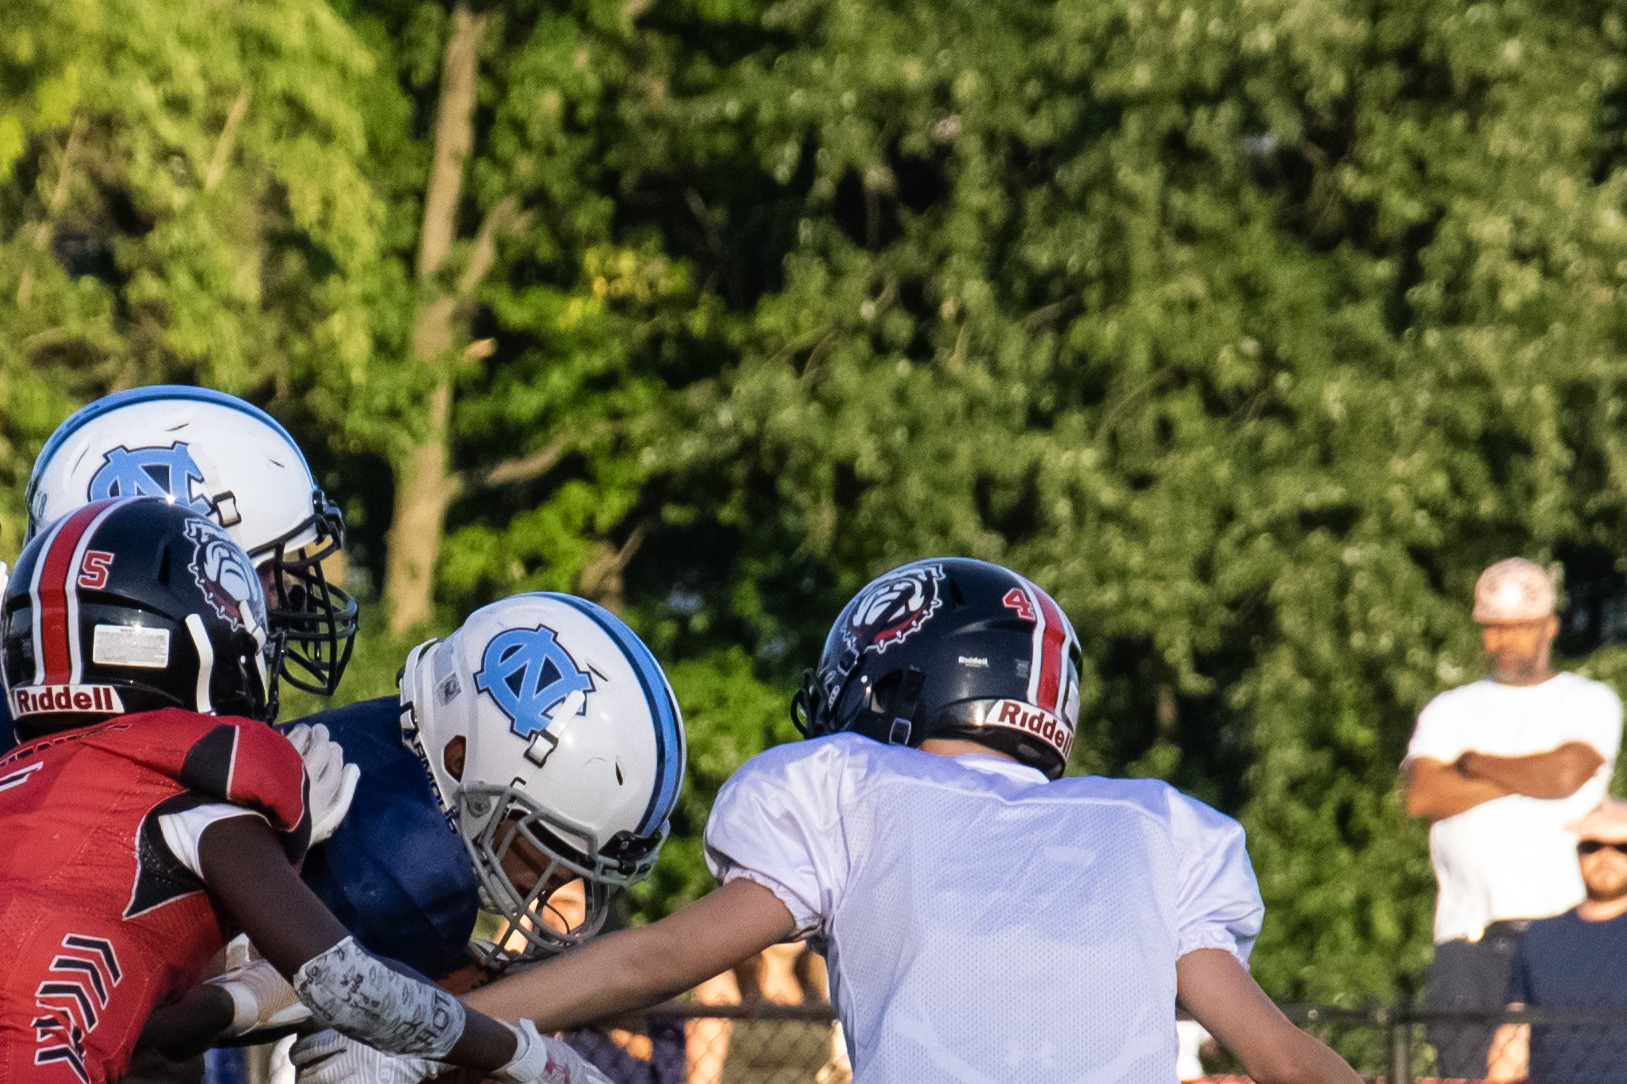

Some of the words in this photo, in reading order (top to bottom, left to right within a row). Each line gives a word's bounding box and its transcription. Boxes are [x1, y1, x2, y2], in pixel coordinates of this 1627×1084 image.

[78, 549, 115, 591] 5
[1002, 588, 1037, 621] 4
[16, 686, 115, 713] Riddell
[997, 700, 1076, 758] Riddell
